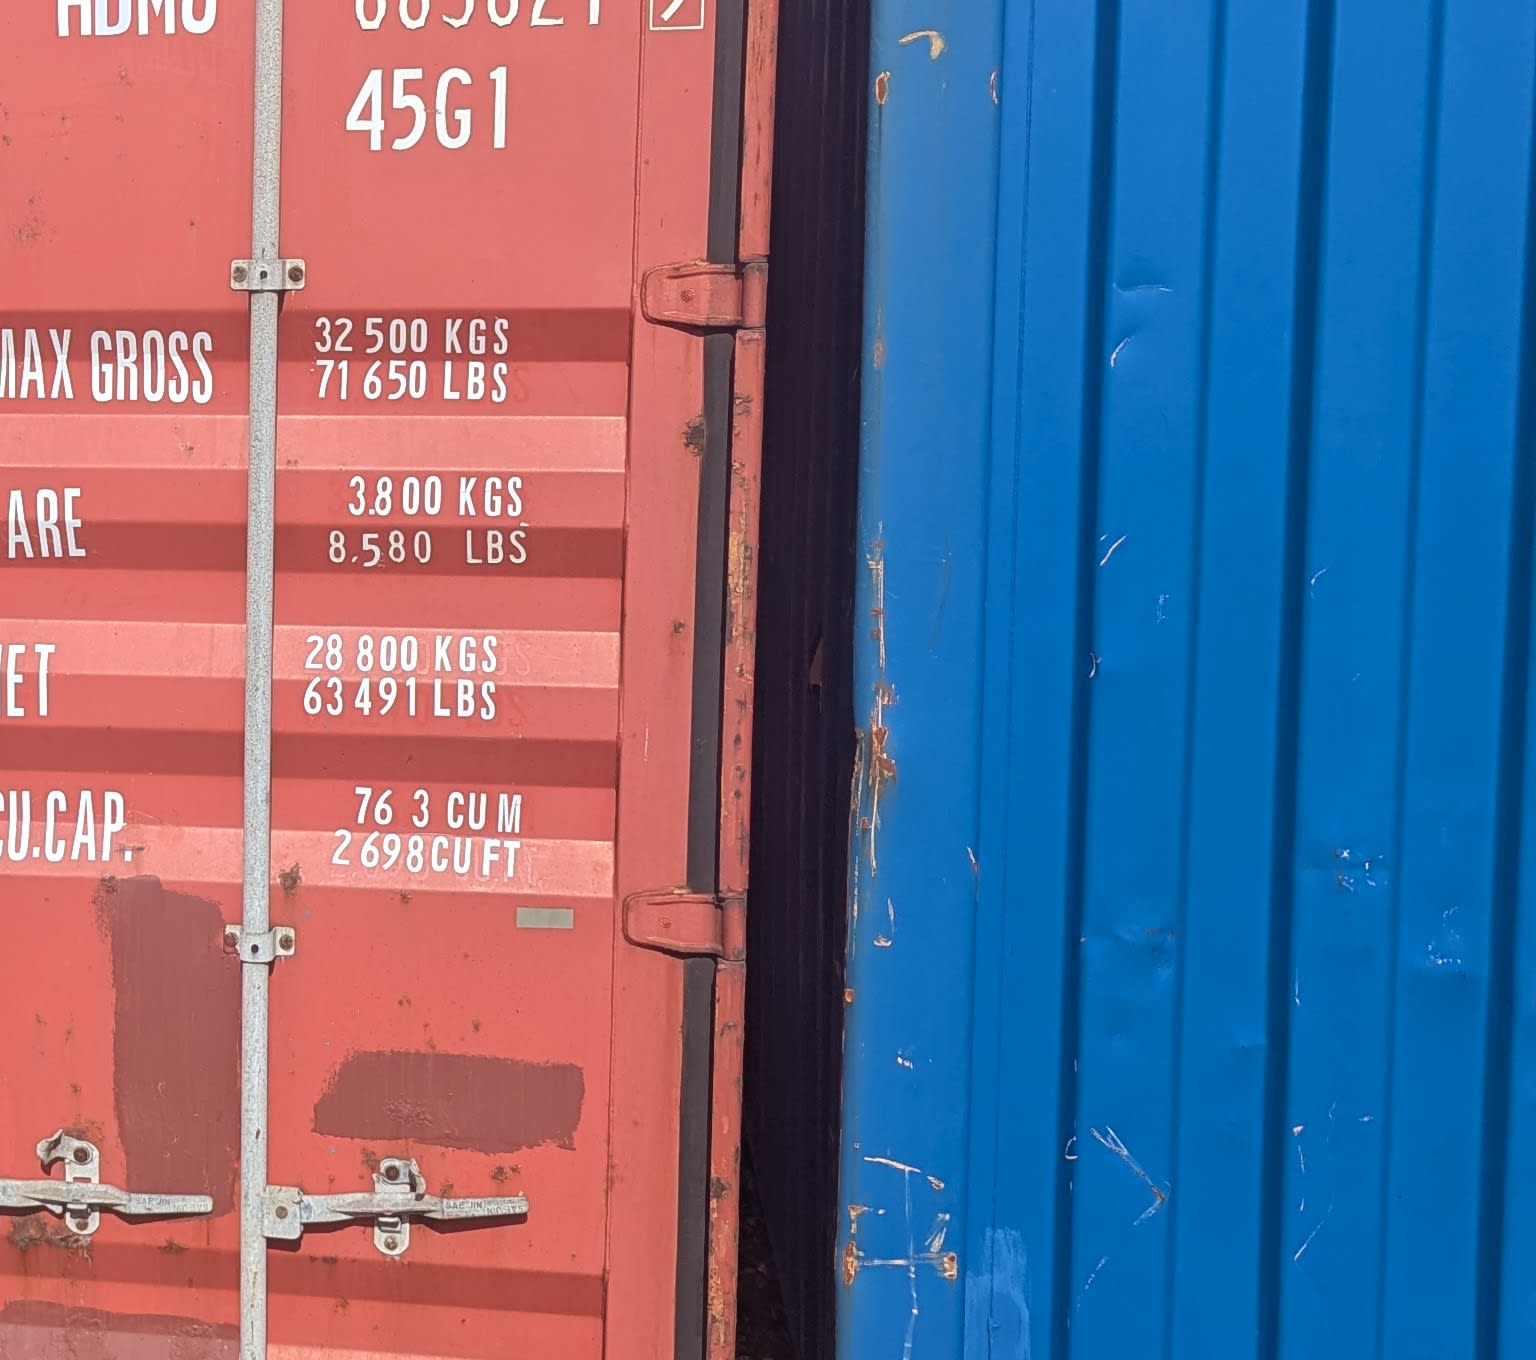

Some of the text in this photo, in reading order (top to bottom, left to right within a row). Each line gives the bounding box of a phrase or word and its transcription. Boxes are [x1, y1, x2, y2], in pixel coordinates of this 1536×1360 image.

[346, 67, 506, 150] 45G1
[91, 330, 212, 403] GROSS
[446, 317, 508, 354] KGS
[444, 361, 507, 402] LBS
[349, 476, 441, 516] 3.800
[460, 477, 521, 516] KGS
[467, 530, 526, 563] LBS
[435, 636, 496, 672] KGS
[434, 679, 495, 719] LBS
